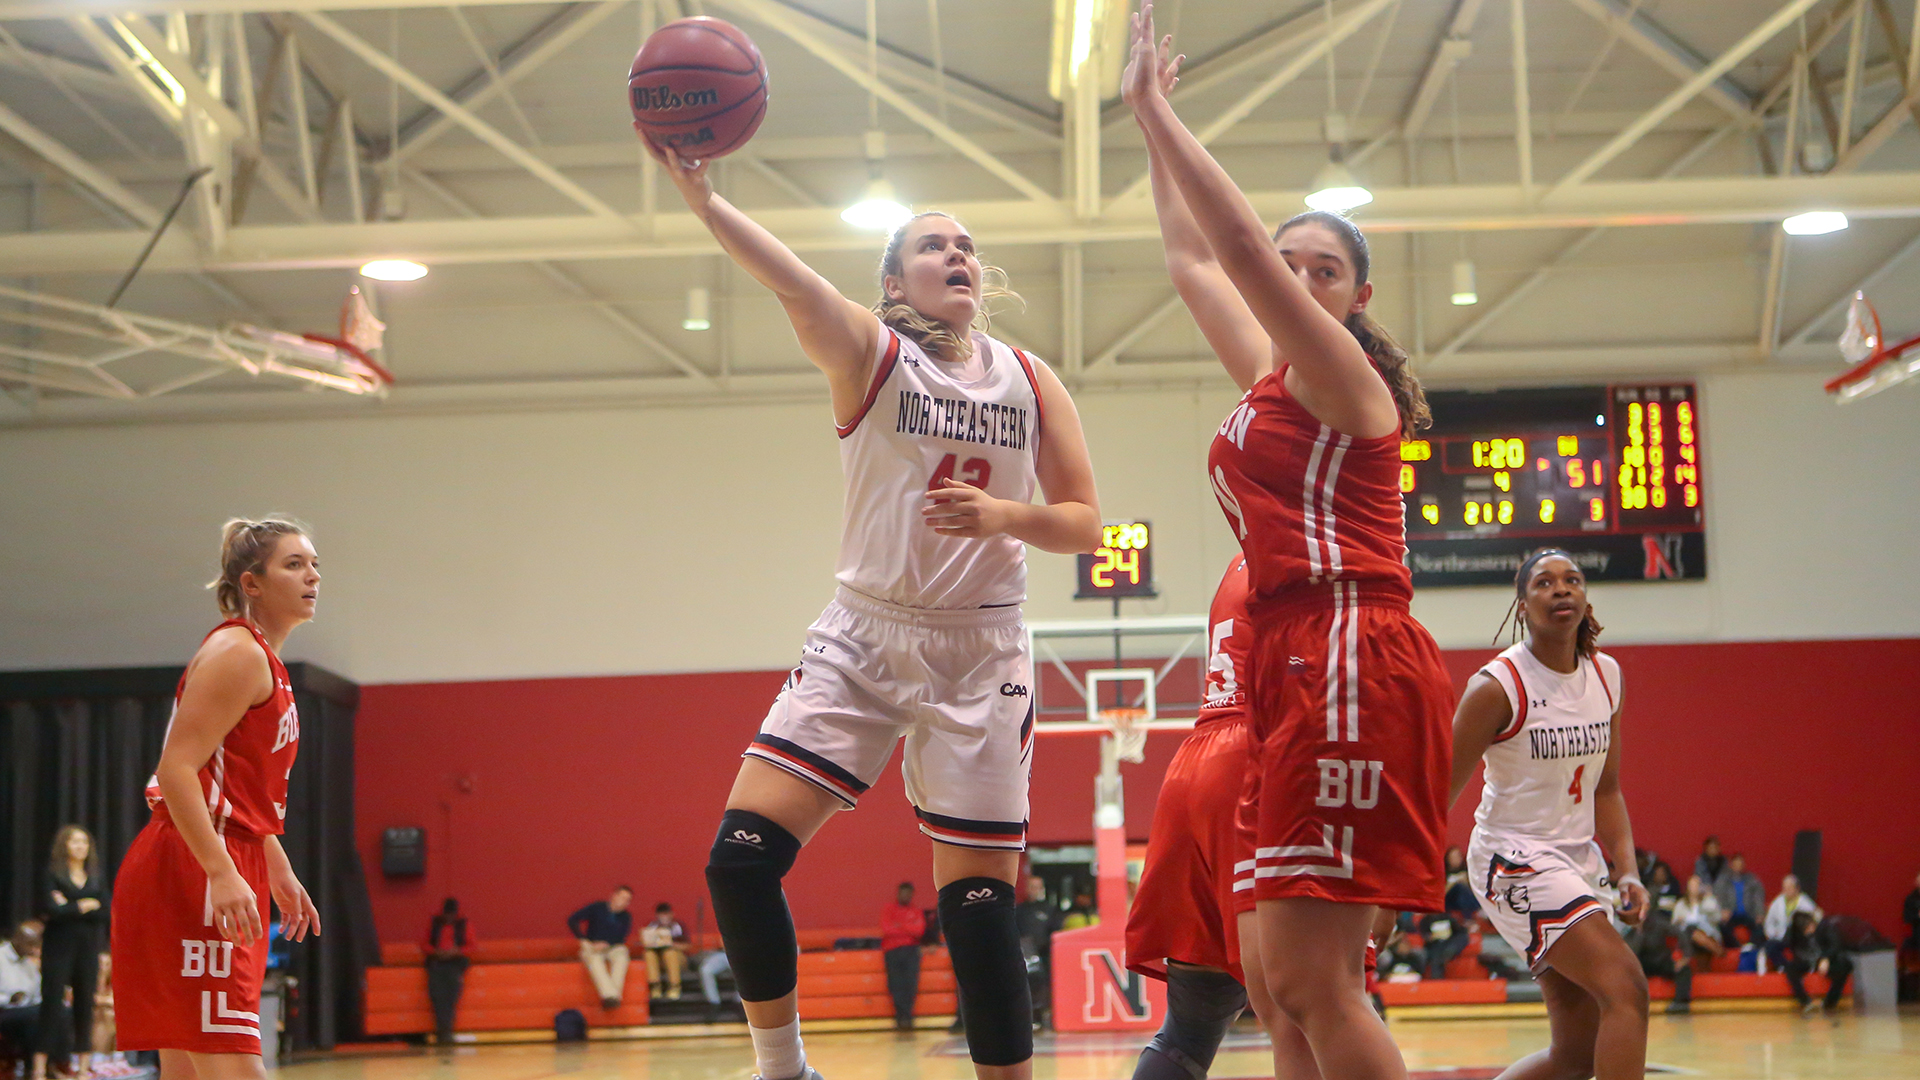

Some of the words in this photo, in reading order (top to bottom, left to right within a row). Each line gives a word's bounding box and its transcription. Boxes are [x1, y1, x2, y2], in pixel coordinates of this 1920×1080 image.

[633, 85, 718, 110] Wilson
[896, 390, 1027, 450] NORTHEASTERN
[1472, 438, 1525, 469] 1:20
[1566, 458, 1603, 488] 51
[1494, 471, 1511, 492] 4
[1539, 498, 1556, 524] 2
[1590, 497, 1605, 522] 3
[1090, 547, 1140, 588] 24
[1206, 618, 1238, 701] 5
[1000, 682, 1028, 699] CAA
[271, 702, 299, 753] BO
[1315, 759, 1384, 809] BU
[1568, 764, 1585, 805] 4
[181, 939, 234, 978] BU
[1081, 948, 1152, 1023] N
